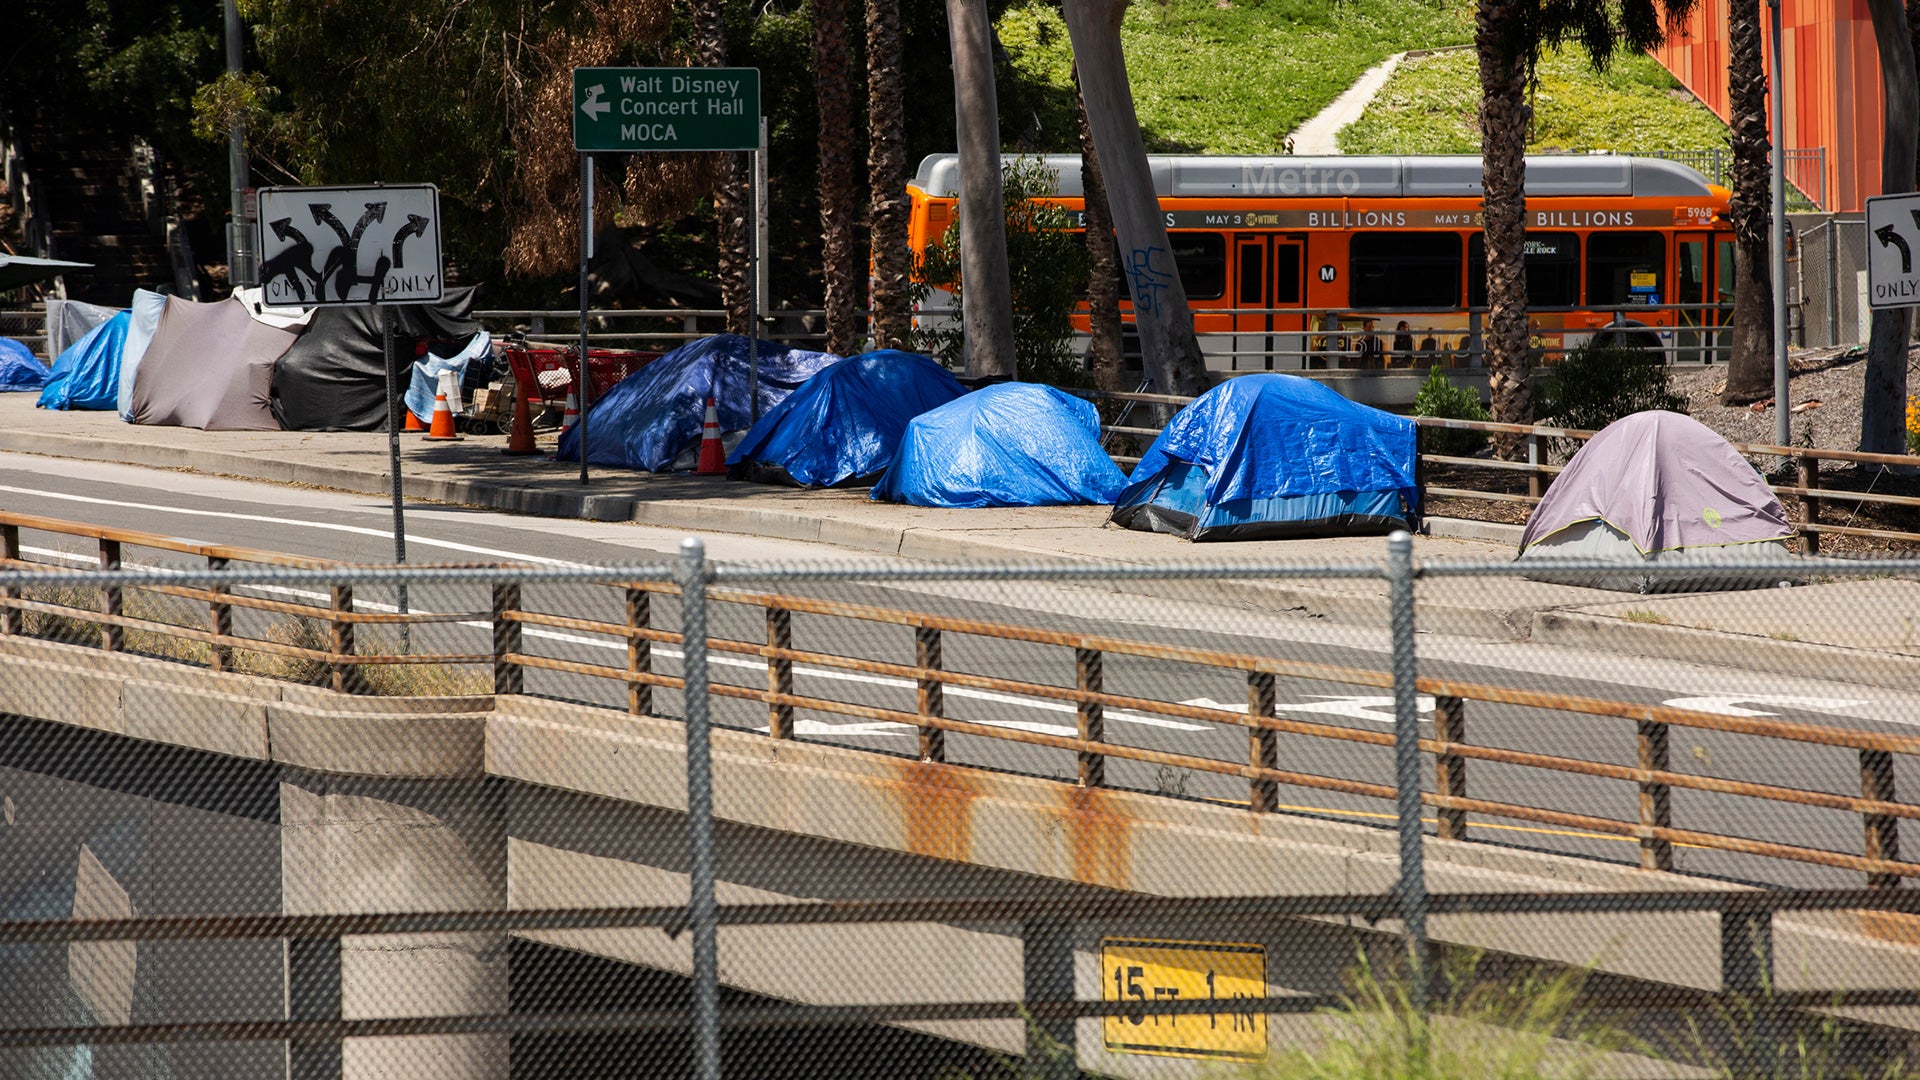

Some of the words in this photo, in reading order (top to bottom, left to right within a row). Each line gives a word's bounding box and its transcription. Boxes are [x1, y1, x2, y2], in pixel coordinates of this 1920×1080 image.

[620, 76, 663, 93] Walt
[672, 76, 740, 97] Disney
[620, 98, 698, 115] Concert
[708, 98, 743, 115] Hall
[621, 124, 678, 141] MOCA
[1241, 163, 1360, 195] Metro
[1205, 215, 1230, 224] MAY
[1234, 215, 1241, 224] 3
[1308, 212, 1406, 227] BILLIONS
[1435, 215, 1458, 224] MAY
[1462, 215, 1470, 224] 3
[1537, 211, 1634, 227] BILLIONS
[1687, 207, 1712, 218] 5968
[272, 279, 316, 297] ONY
[388, 274, 435, 293] ONLY
[1876, 280, 1920, 298] ONLY
[1338, 338, 1345, 348] 3
[1114, 966, 1146, 1025] 15
[1154, 987, 1179, 1027] FT
[1206, 969, 1216, 1030] 1
[1233, 992, 1255, 1033] IN
